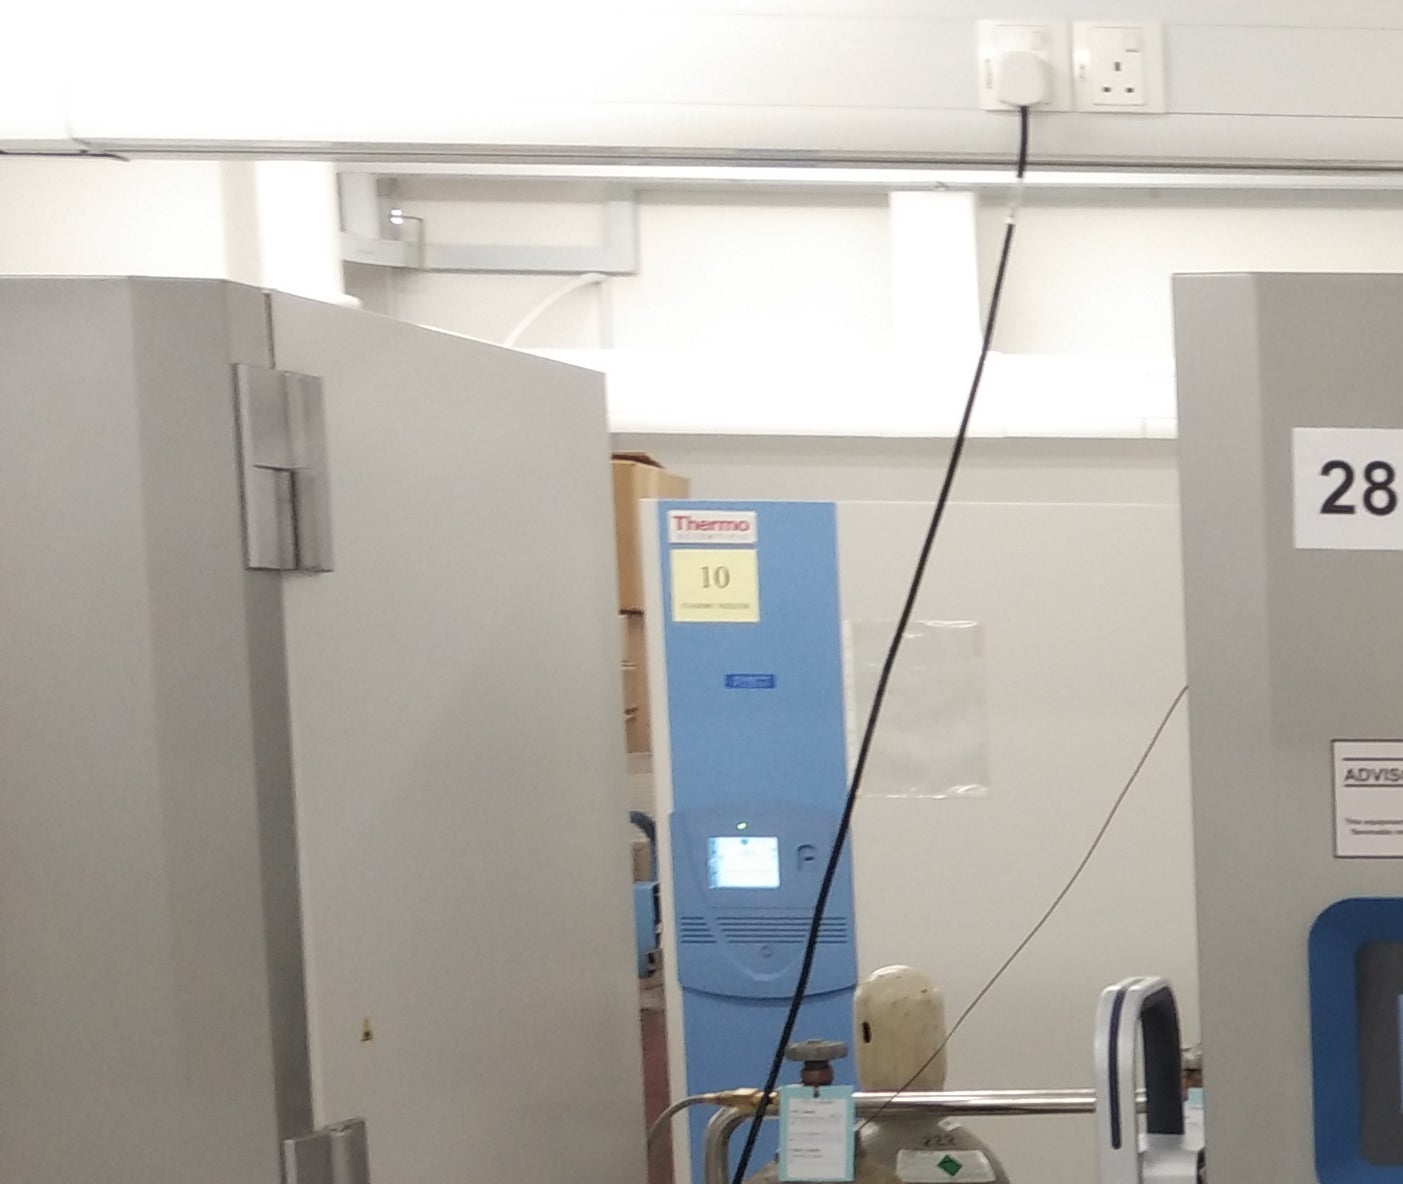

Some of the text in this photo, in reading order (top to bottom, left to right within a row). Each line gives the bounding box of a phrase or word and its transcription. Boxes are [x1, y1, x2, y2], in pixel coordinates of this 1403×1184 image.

[1319, 459, 1398, 517] 28
[673, 514, 751, 532] Thermo
[700, 565, 731, 589] 10
